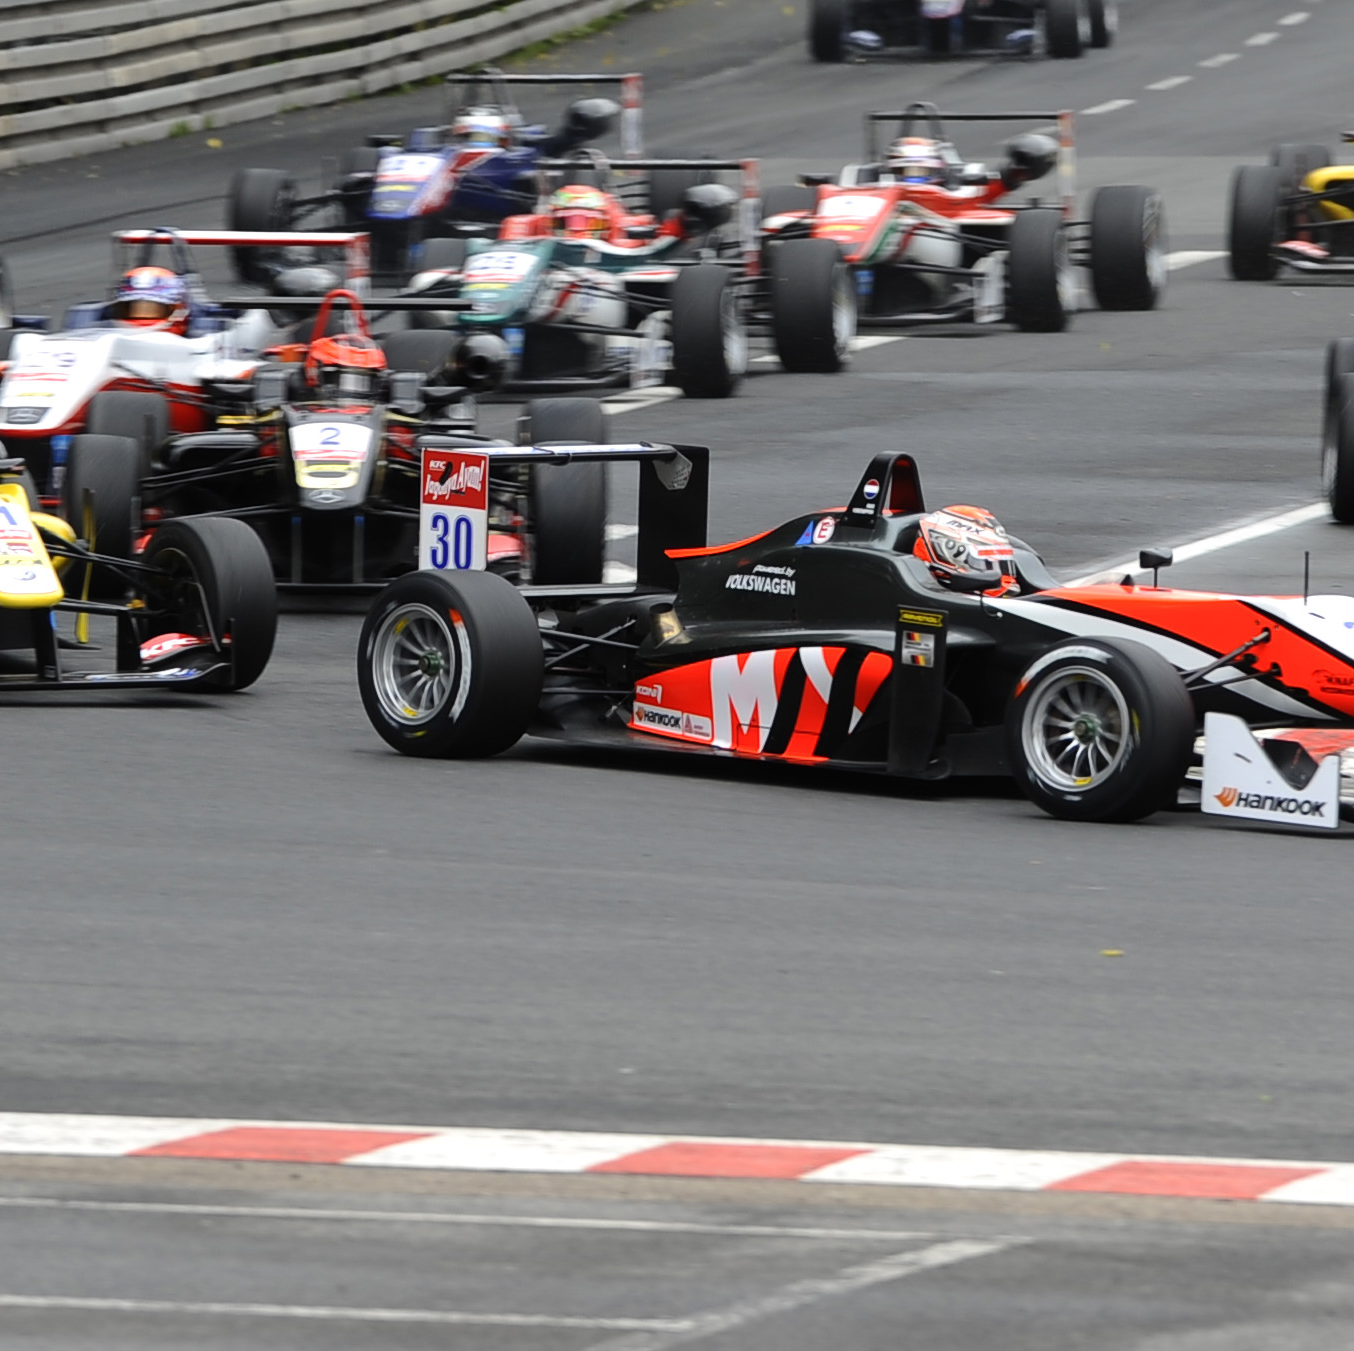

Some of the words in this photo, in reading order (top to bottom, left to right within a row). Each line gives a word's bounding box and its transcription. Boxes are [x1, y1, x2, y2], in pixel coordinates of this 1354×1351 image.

[319, 426, 341, 446] 2
[429, 512, 473, 570] 30
[725, 574, 796, 596] VOLKSWAGEN
